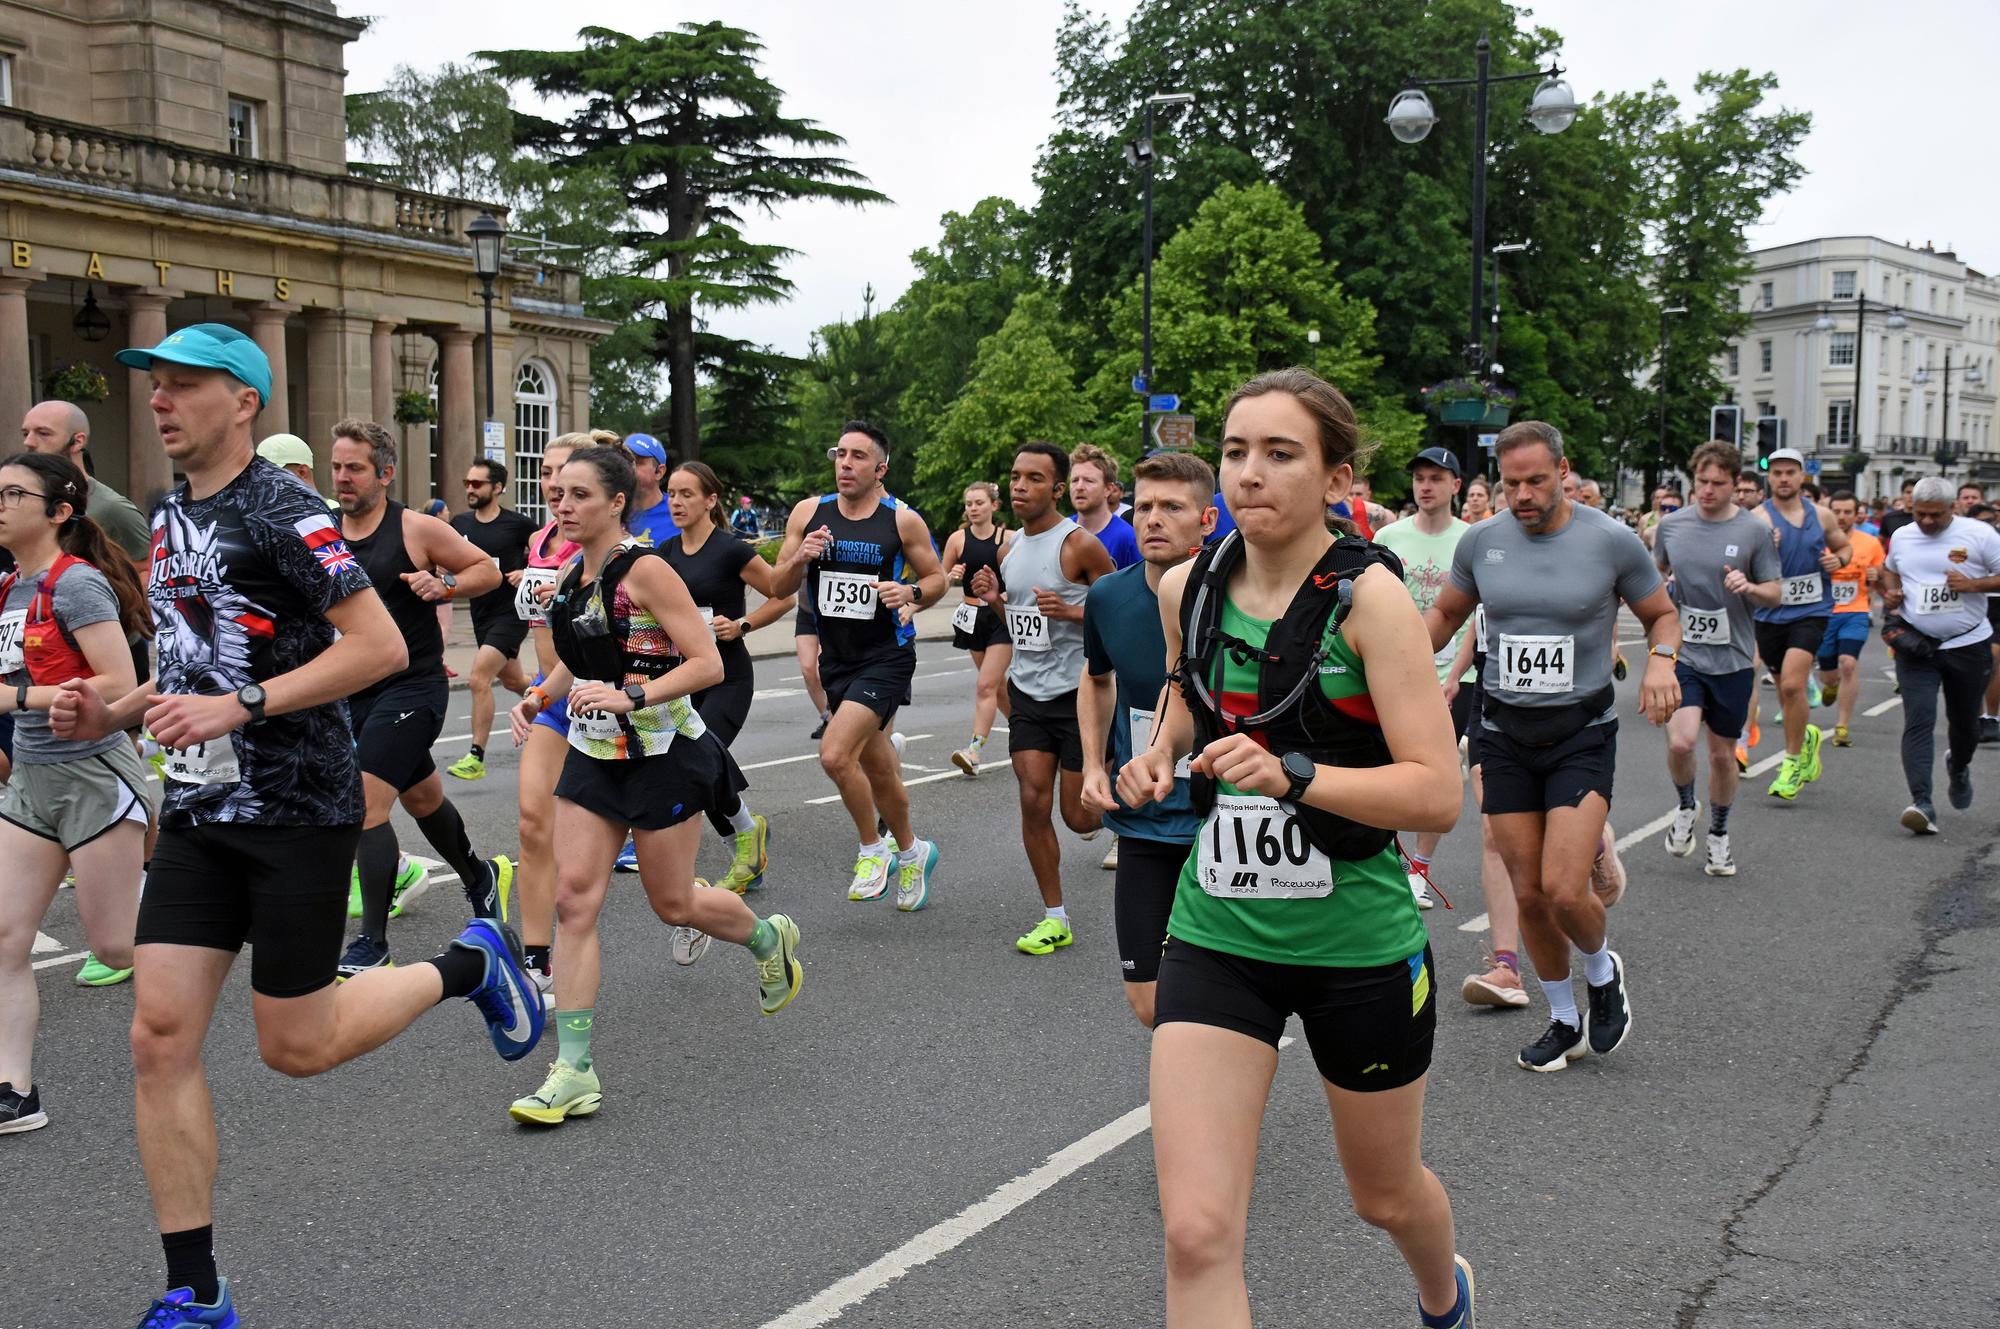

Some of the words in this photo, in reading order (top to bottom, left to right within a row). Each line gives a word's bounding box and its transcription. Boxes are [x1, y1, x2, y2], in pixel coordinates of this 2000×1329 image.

[836, 540, 881, 555] PROSTATE
[835, 550, 869, 564] CANCER
[871, 553, 883, 566] UK
[155, 587, 178, 600] RACE
[827, 581, 871, 605] 1530
[1789, 579, 1814, 596] 326
[1833, 586, 1854, 598] 829
[1010, 613, 1042, 637] 1529
[1688, 614, 1718, 633] 259
[1507, 646, 1565, 675] 1644
[1231, 804, 1243, 812] Spa
[1213, 815, 1311, 867] 1160
[1271, 877, 1327, 889] Raceways
